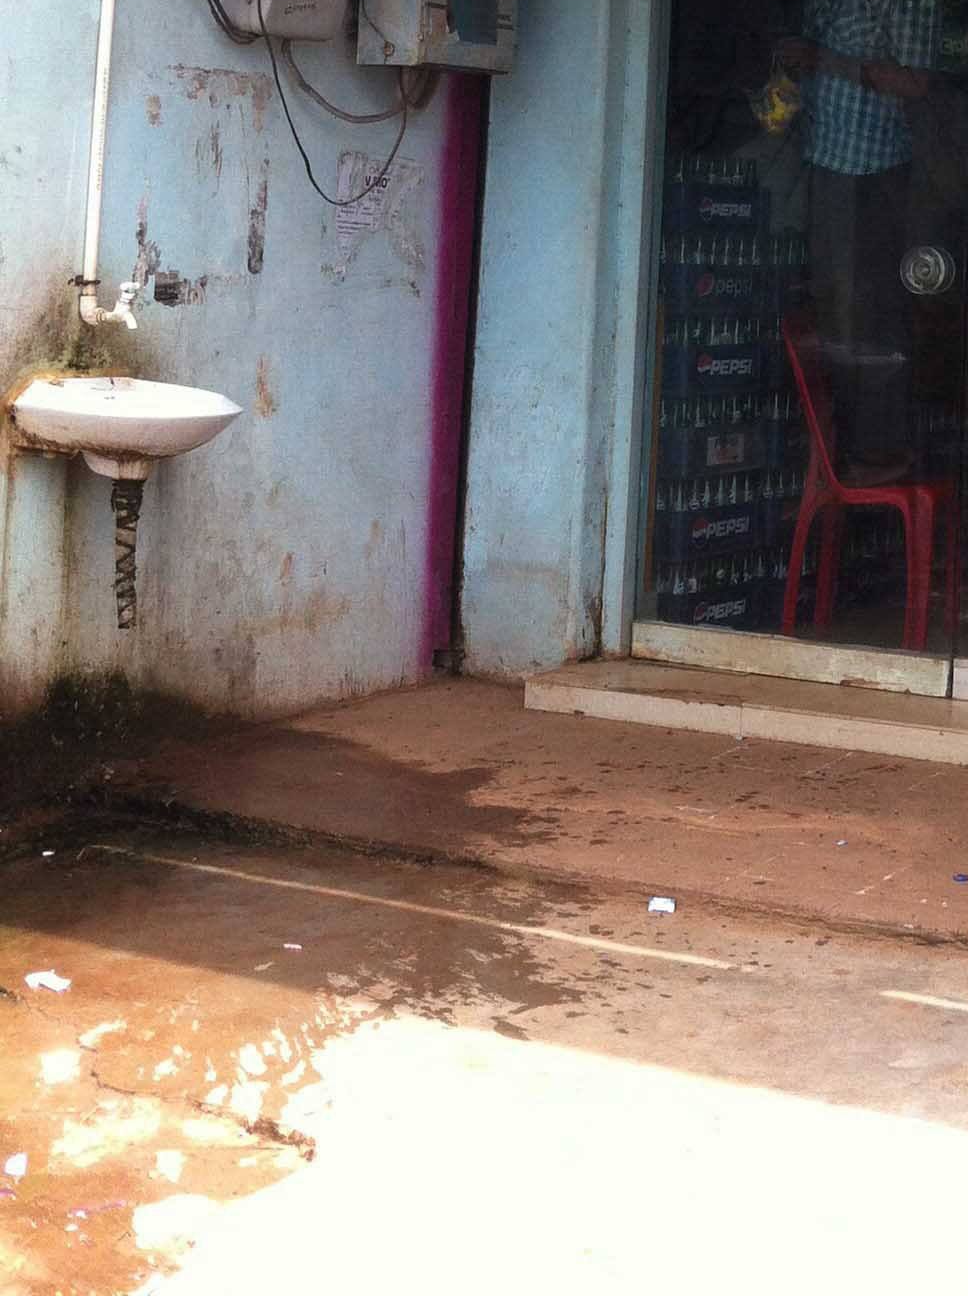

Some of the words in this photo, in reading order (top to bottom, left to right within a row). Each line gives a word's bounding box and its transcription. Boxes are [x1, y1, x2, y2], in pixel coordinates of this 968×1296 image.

[710, 202, 752, 217] PEPSI
[709, 359, 752, 375] PEPSI
[705, 515, 750, 542] PEPSI
[705, 599, 747, 621] PEPSI
